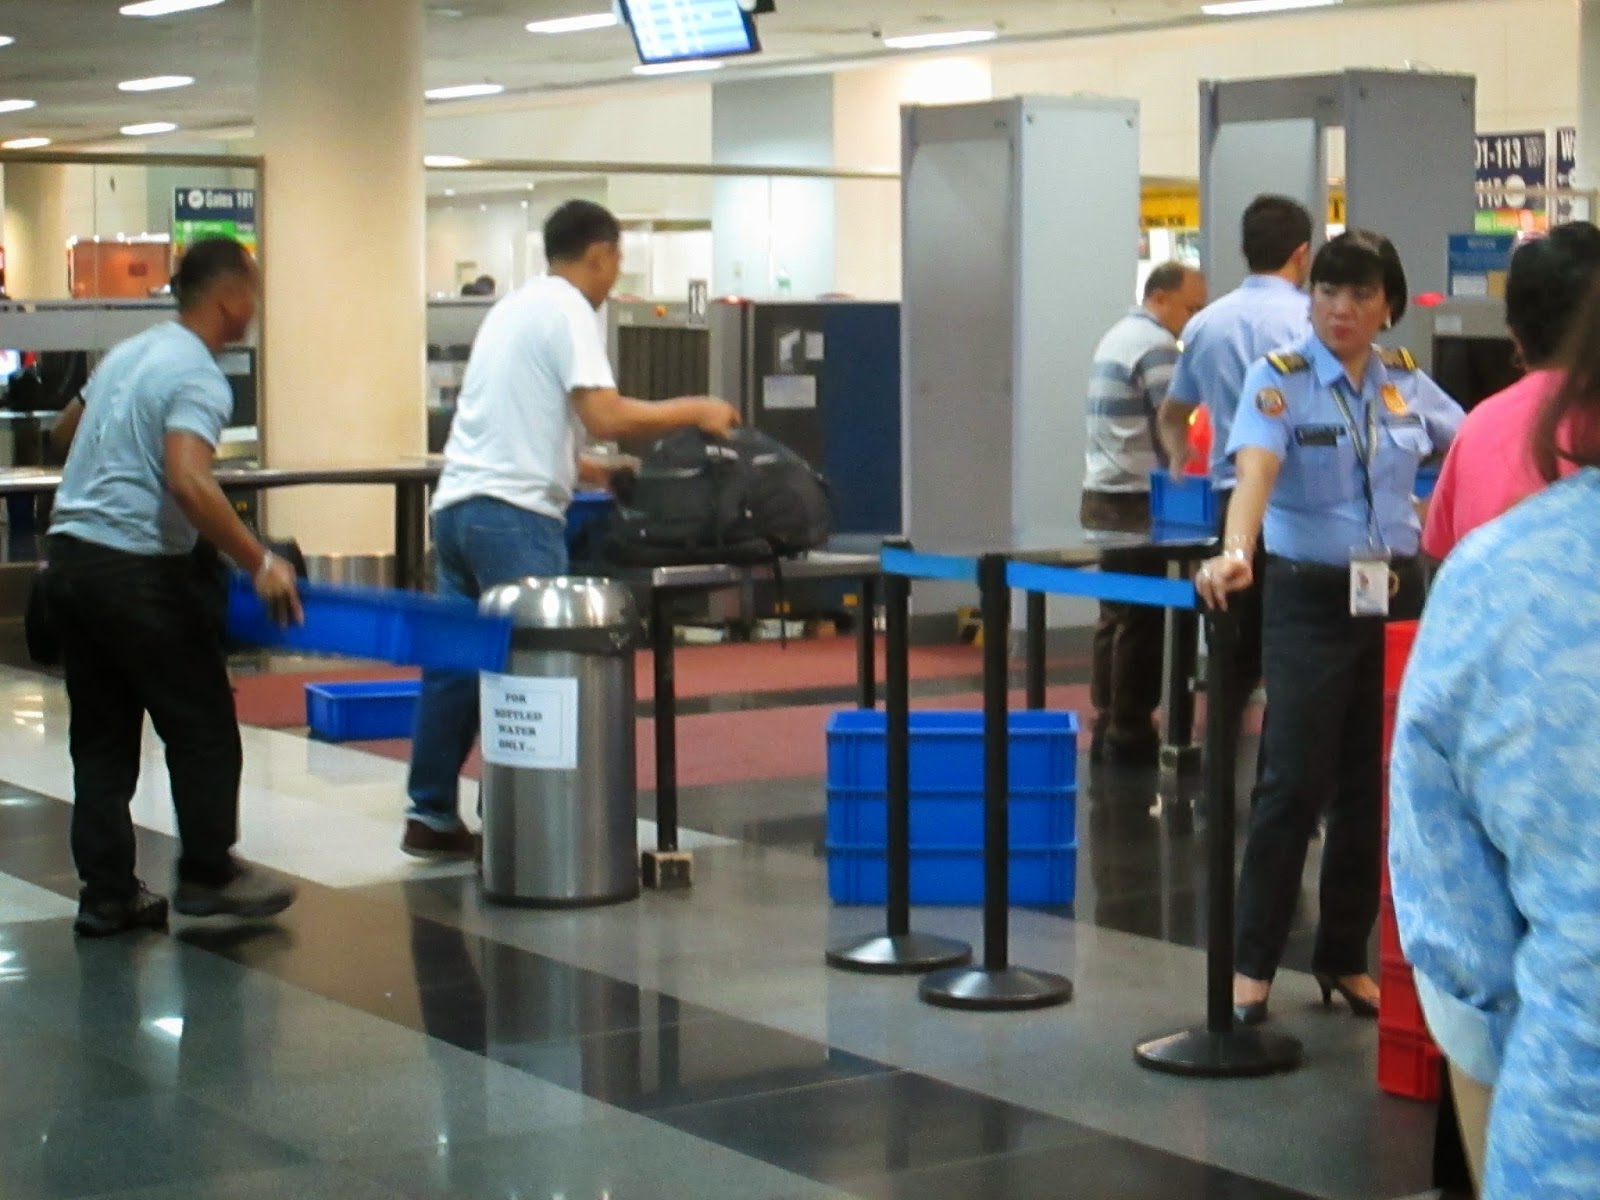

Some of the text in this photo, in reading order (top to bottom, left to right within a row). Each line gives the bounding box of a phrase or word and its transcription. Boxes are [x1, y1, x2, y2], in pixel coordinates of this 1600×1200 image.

[505, 693, 527, 704] FOR
[494, 708, 544, 721] BOTTLED
[498, 724, 537, 737] WATER
